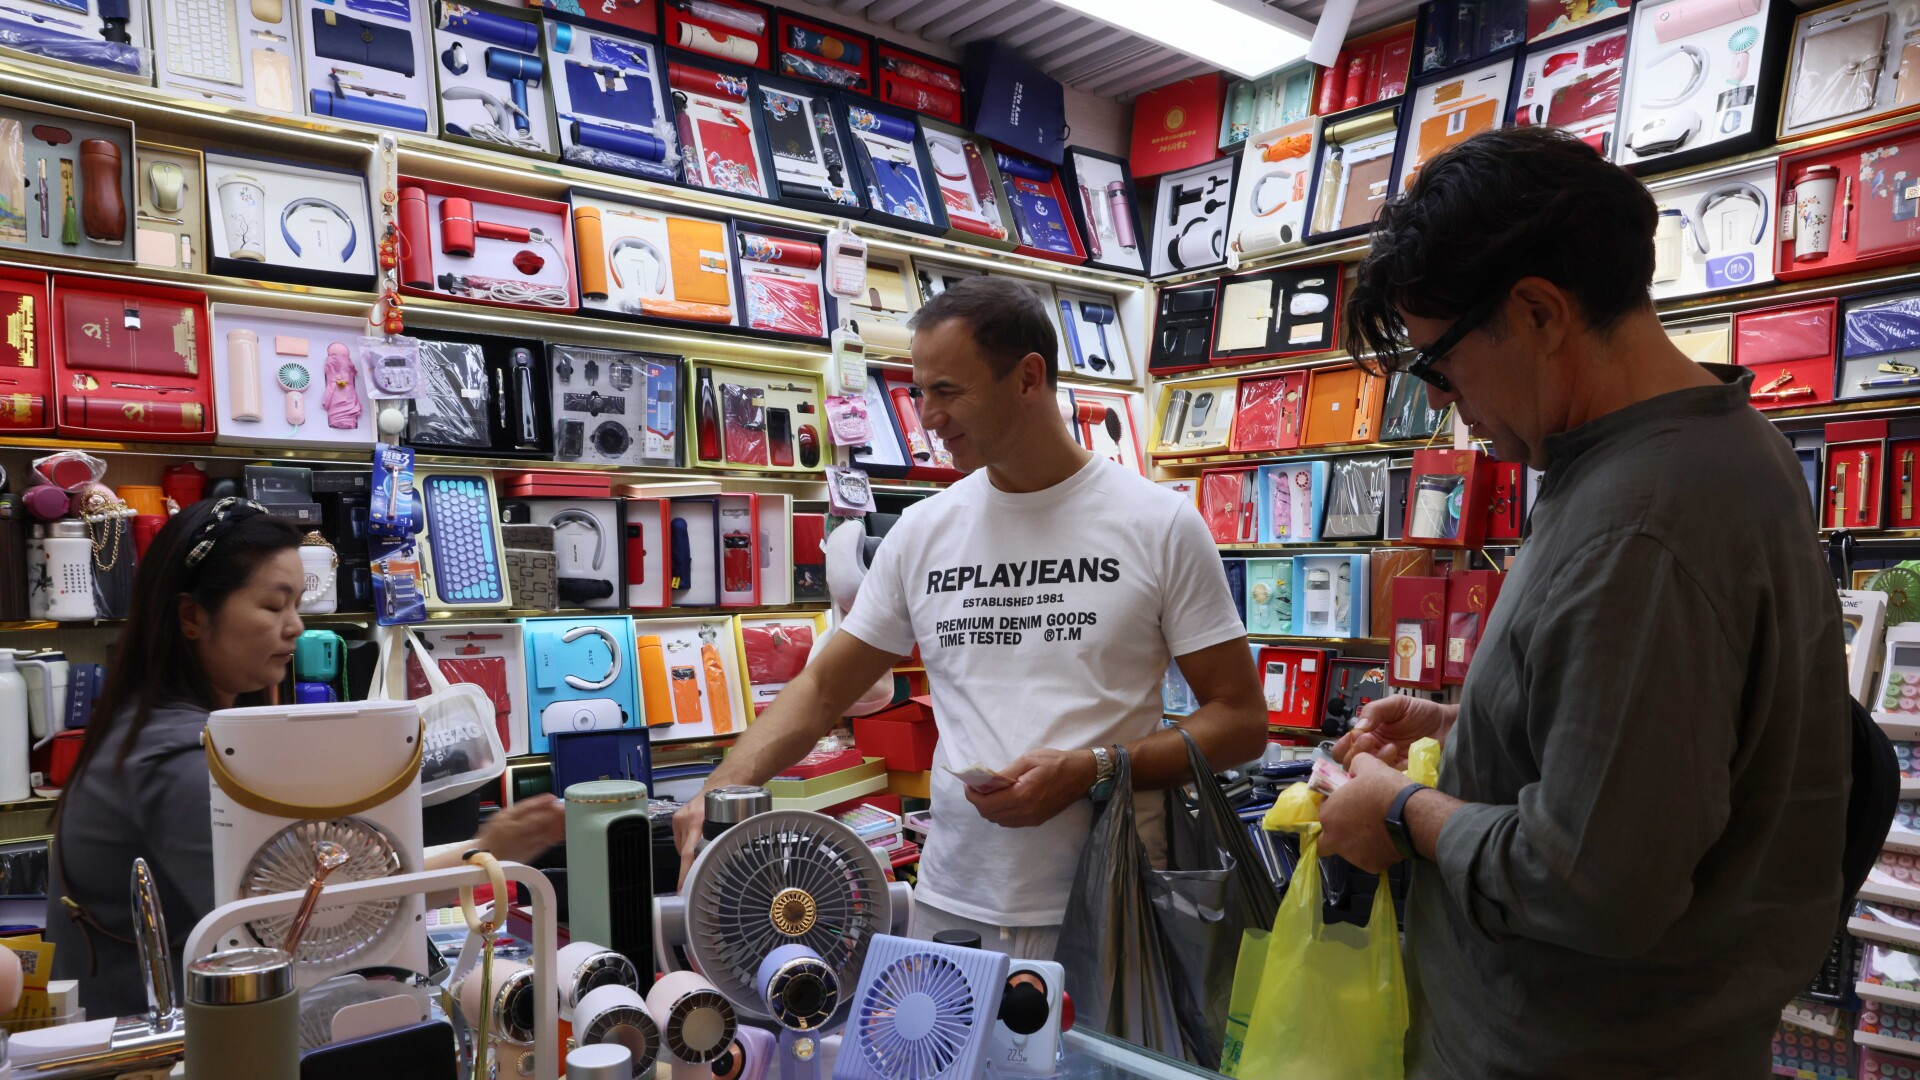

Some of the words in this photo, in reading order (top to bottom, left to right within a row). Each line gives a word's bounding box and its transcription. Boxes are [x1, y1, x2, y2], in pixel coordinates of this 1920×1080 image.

[926, 557, 1120, 594] REPLAYJEANS
[962, 596, 1034, 608] ESTABLISHED
[1036, 593, 1064, 604] 1981
[936, 616, 995, 634] PREMIUM
[1000, 615, 1042, 630] DENIM
[1046, 612, 1097, 627] GOODS
[939, 633, 965, 648] TIME
[969, 631, 1022, 646] TESTED
